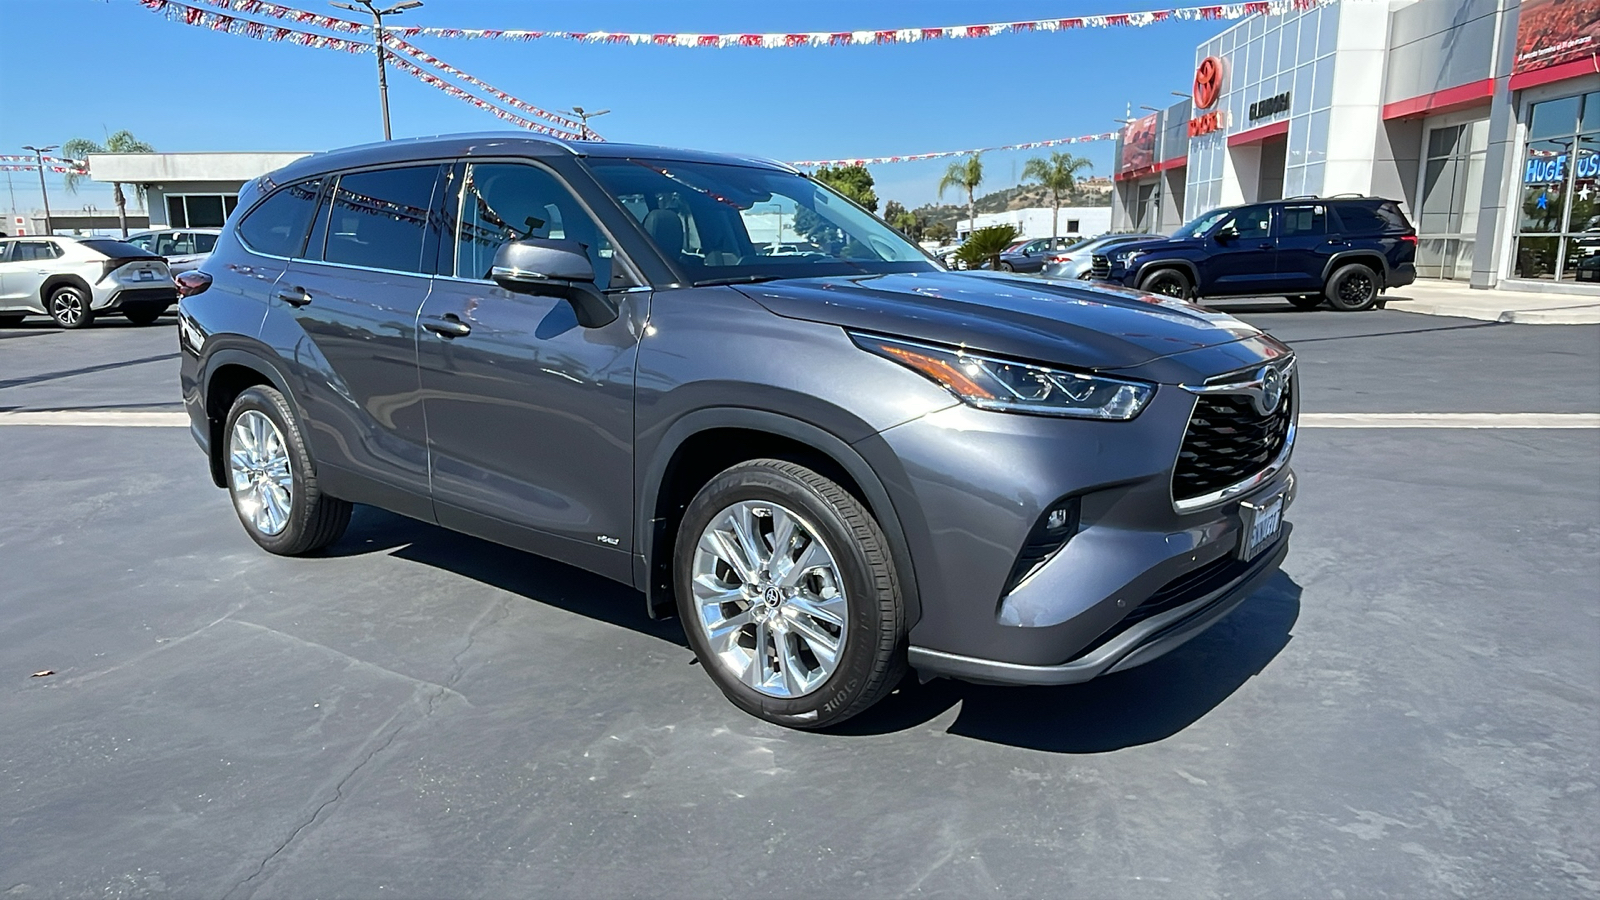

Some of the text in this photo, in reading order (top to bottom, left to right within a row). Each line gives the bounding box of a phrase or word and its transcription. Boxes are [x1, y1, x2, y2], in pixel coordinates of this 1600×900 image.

[1538, 46, 1556, 56] termina
[1574, 36, 1592, 45] marzo
[1249, 91, 1290, 121] GLENDORA
[1188, 109, 1233, 137] TOYOTA
